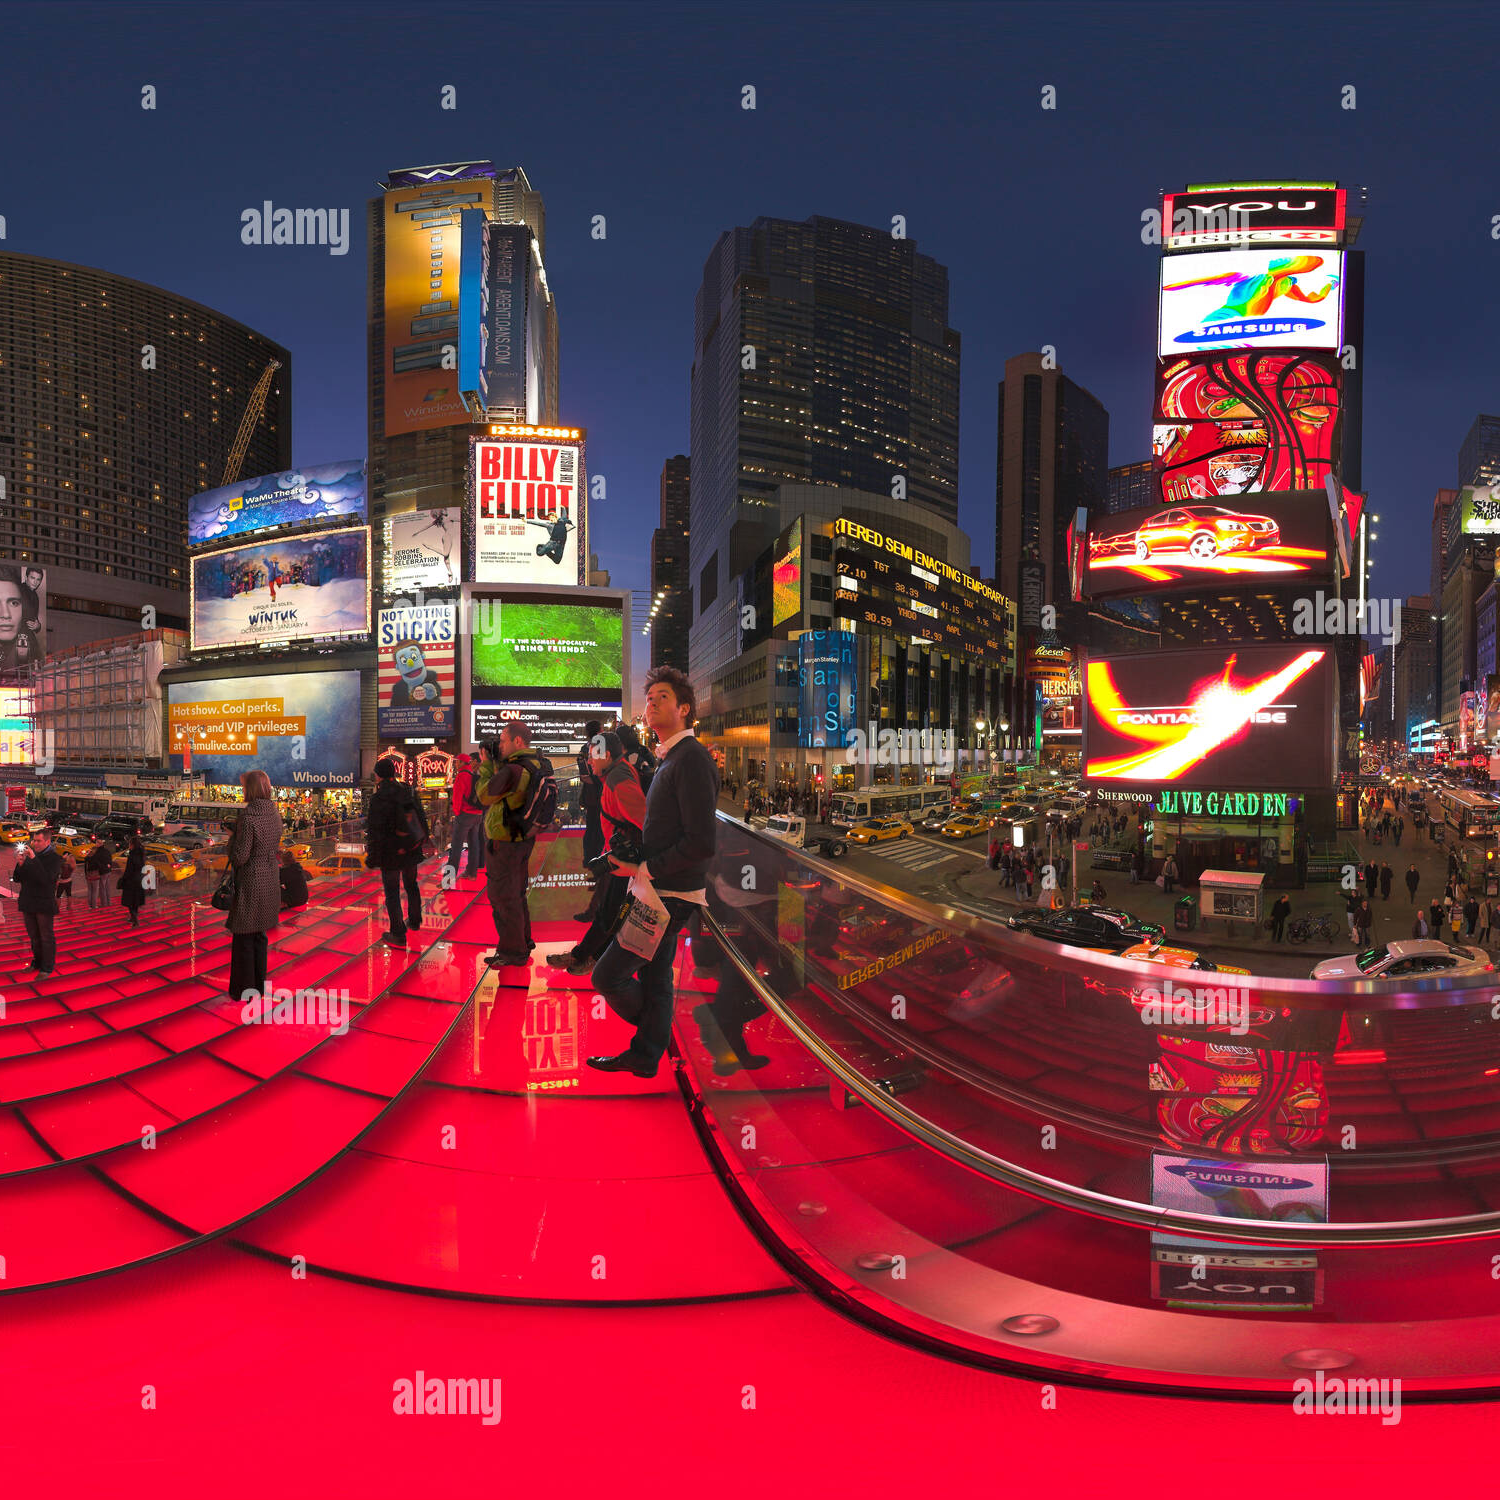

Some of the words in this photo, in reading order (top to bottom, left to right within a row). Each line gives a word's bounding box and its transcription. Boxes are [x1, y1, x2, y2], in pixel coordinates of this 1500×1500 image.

[1187, 201, 1316, 214] YOU
[1174, 232, 1272, 245] HSBC
[495, 290, 511, 365] ARGENTLOANS.COM
[1192, 323, 1307, 337] SAMSUNG
[481, 446, 559, 482] BILLY
[560, 450, 573, 470] MUSICAL
[560, 470, 573, 483] THE
[245, 494, 273, 504] WaMu
[274, 486, 308, 497] Theater
[481, 482, 573, 519] ELLIOT
[394, 553, 423, 561] ROBBINS
[394, 557, 439, 567] CELEBRATION
[774, 545, 800, 571] Bloomberg
[837, 563, 867, 580] 27.10
[873, 560, 890, 574] TGT
[885, 537, 913, 561] SEMI
[915, 550, 961, 583] ENACTING
[962, 573, 1004, 606] TEMPORARY
[895, 582, 920, 598] 38.39
[924, 581, 937, 593] TRV
[1022, 567, 1040, 627] HERSHEY'S
[381, 610, 404, 622] NOT
[408, 607, 451, 619] VOTING
[864, 611, 892, 627] 30.59
[898, 606, 917, 621] YHOO
[241, 625, 267, 634] OCTOBER
[278, 623, 303, 631] JANUARY
[382, 618, 452, 644] SUCKS
[922, 628, 943, 642] 12.93
[946, 624, 962, 636] AAPL
[1035, 645, 1064, 656] Reese's
[173, 706, 190, 716] Hot
[191, 704, 220, 715] show.
[222, 702, 245, 714] Cool
[247, 701, 280, 716] perks.
[500, 710, 540, 720] CNN.com:
[433, 711, 445, 723] Q
[207, 721, 224, 733] and
[226, 721, 245, 732] VIP
[246, 720, 299, 736] privileges
[174, 742, 182, 751] at
[422, 758, 448, 773] ROXY
[293, 771, 327, 783] Whoo
[329, 771, 354, 783] hoo!
[1097, 788, 1153, 803] SHERWOOD
[1207, 791, 1287, 817] GARDEN
